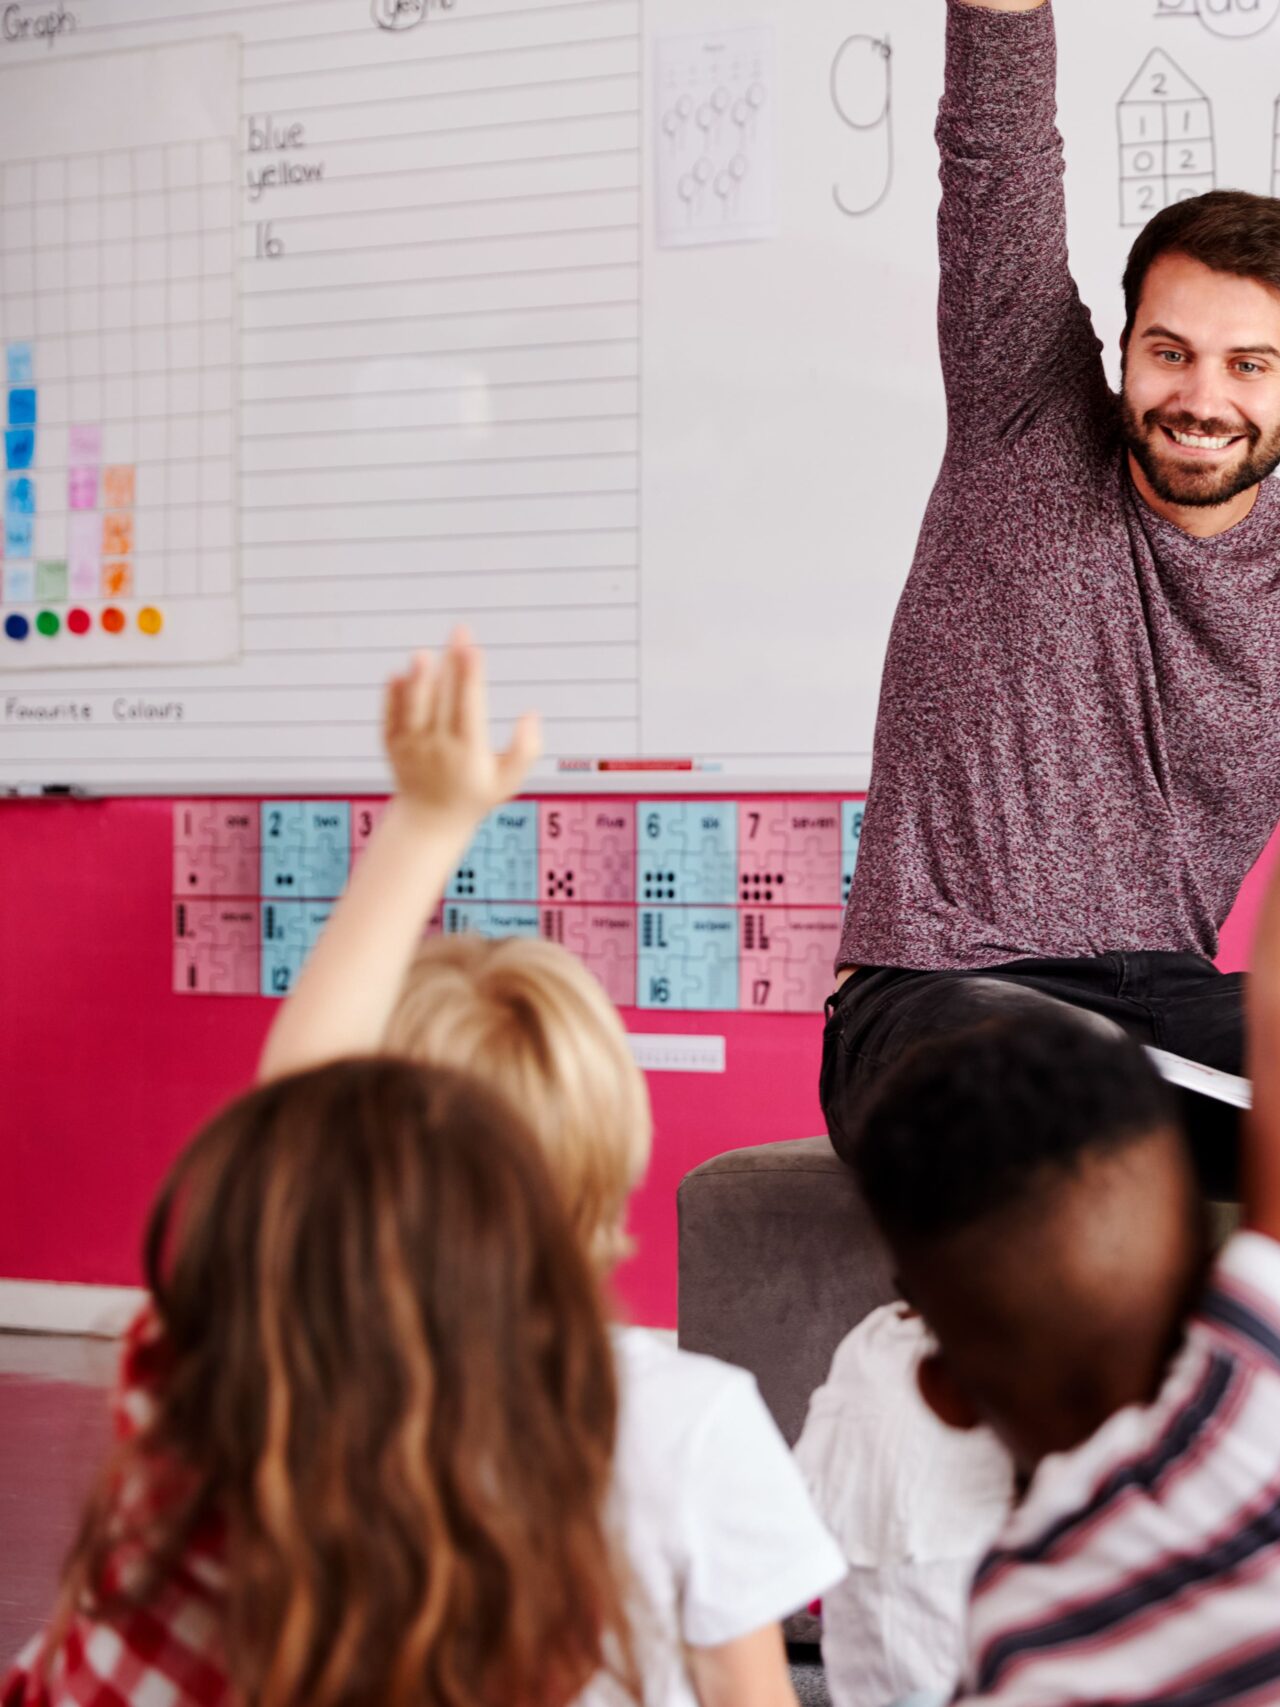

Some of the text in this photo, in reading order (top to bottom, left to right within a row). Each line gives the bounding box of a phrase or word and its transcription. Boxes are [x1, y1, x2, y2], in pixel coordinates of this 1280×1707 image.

[3, 1, 77, 47] Graph
[1151, 73, 1168, 95] 2
[249, 114, 305, 152] blue
[829, 31, 894, 218] g
[1133, 149, 1195, 172] 0 2
[247, 160, 325, 203] yellow
[1138, 185, 1154, 210] 2
[255, 221, 285, 260] 16
[269, 811, 282, 837] 2
[359, 811, 372, 838] 3
[547, 812, 561, 838] 5
[647, 813, 661, 839] 6
[747, 812, 760, 839] 7
